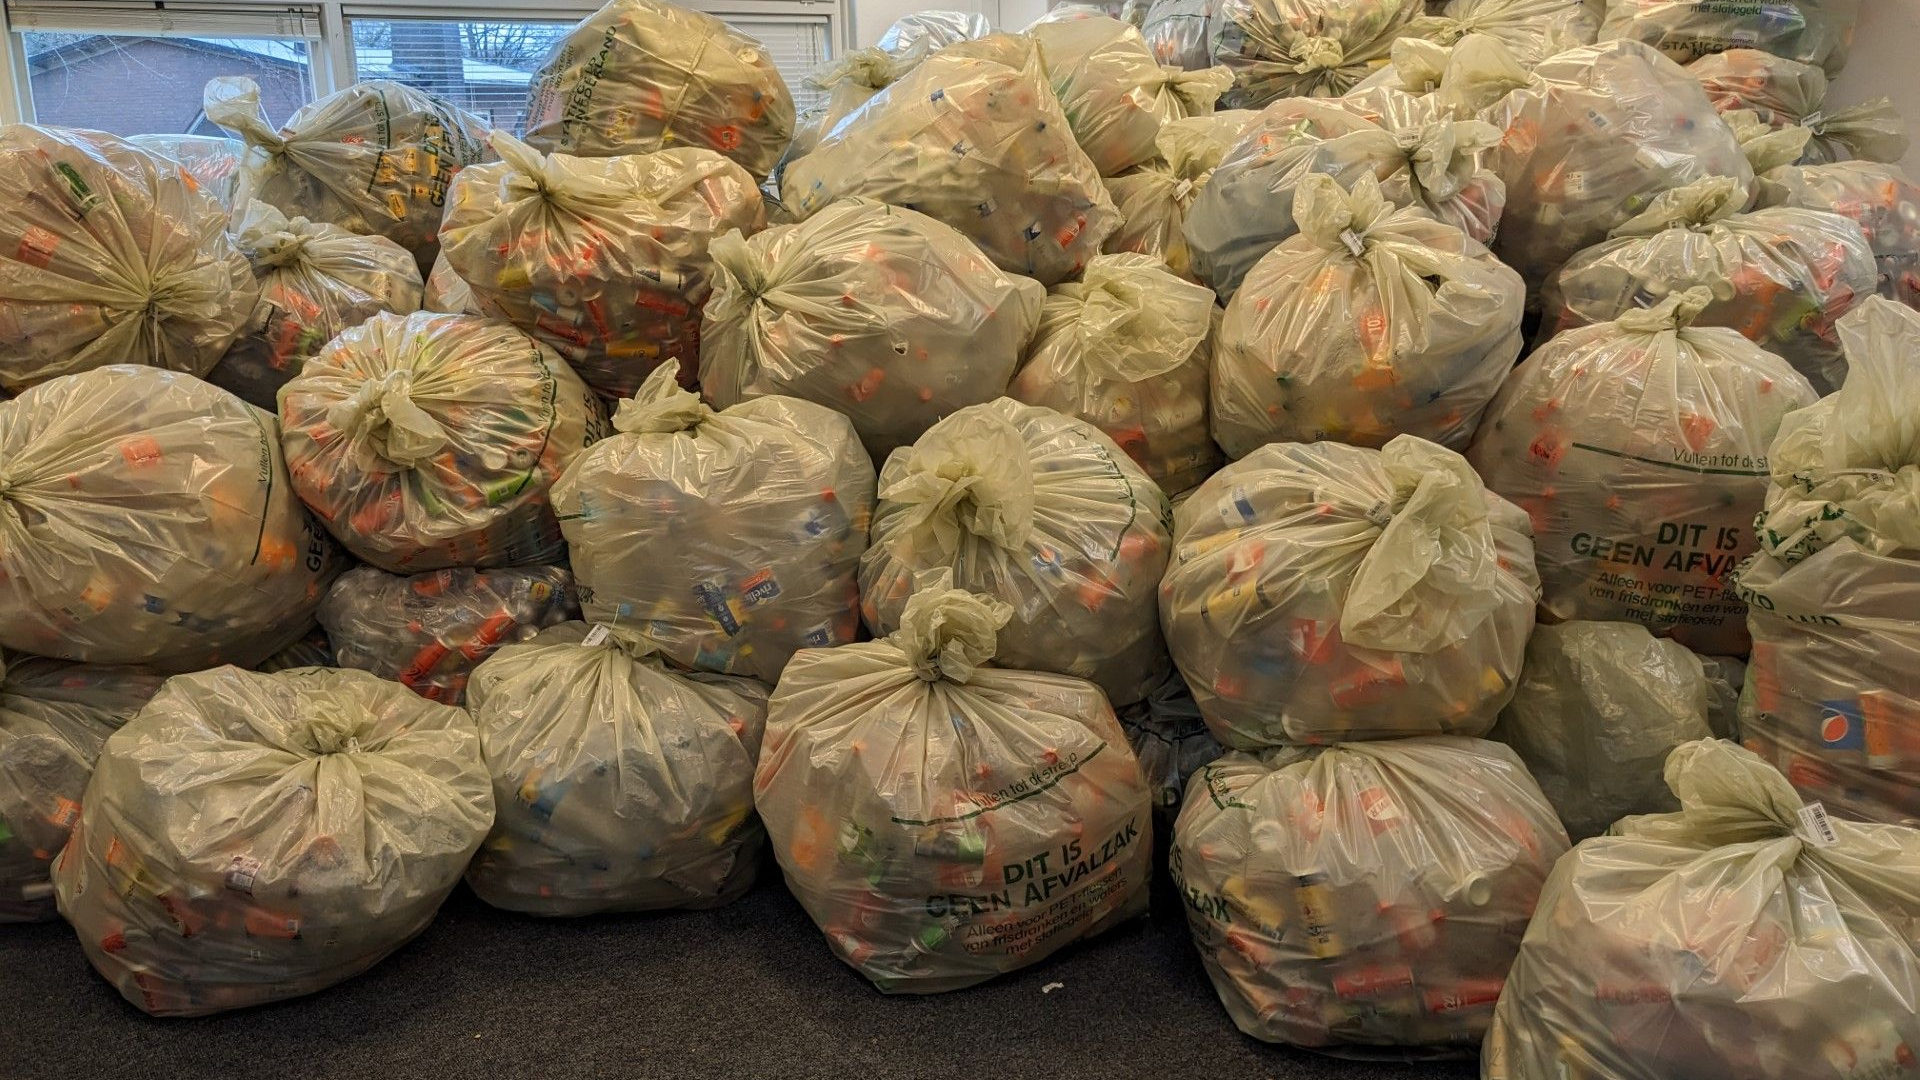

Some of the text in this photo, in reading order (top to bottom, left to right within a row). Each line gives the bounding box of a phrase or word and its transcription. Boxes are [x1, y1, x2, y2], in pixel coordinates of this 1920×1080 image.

[1673, 448, 1717, 467] Vullen
[1721, 454, 1738, 468] tot
[1571, 532, 1655, 567] GEEN
[1657, 523, 1707, 547] DIT
[1716, 527, 1740, 551] IS
[1597, 572, 1644, 591] Alleen
[1648, 583, 1680, 596] voor
[1589, 586, 1614, 599] van
[1618, 588, 1699, 614] frisdranken
[1702, 602, 1720, 614] en
[1626, 606, 1725, 628] met statiegeld
[1009, 779, 1029, 795] tot
[926, 816, 1138, 918] GEEN AFVALZAK
[1003, 838, 1082, 885] DIT IS
[967, 867, 1123, 939] Alleen voor PET-flessen
[963, 937, 990, 952] van
[993, 910, 1069, 947] frisdranken
[1071, 901, 1087, 914] en
[1005, 907, 1094, 955] met statiegeld
